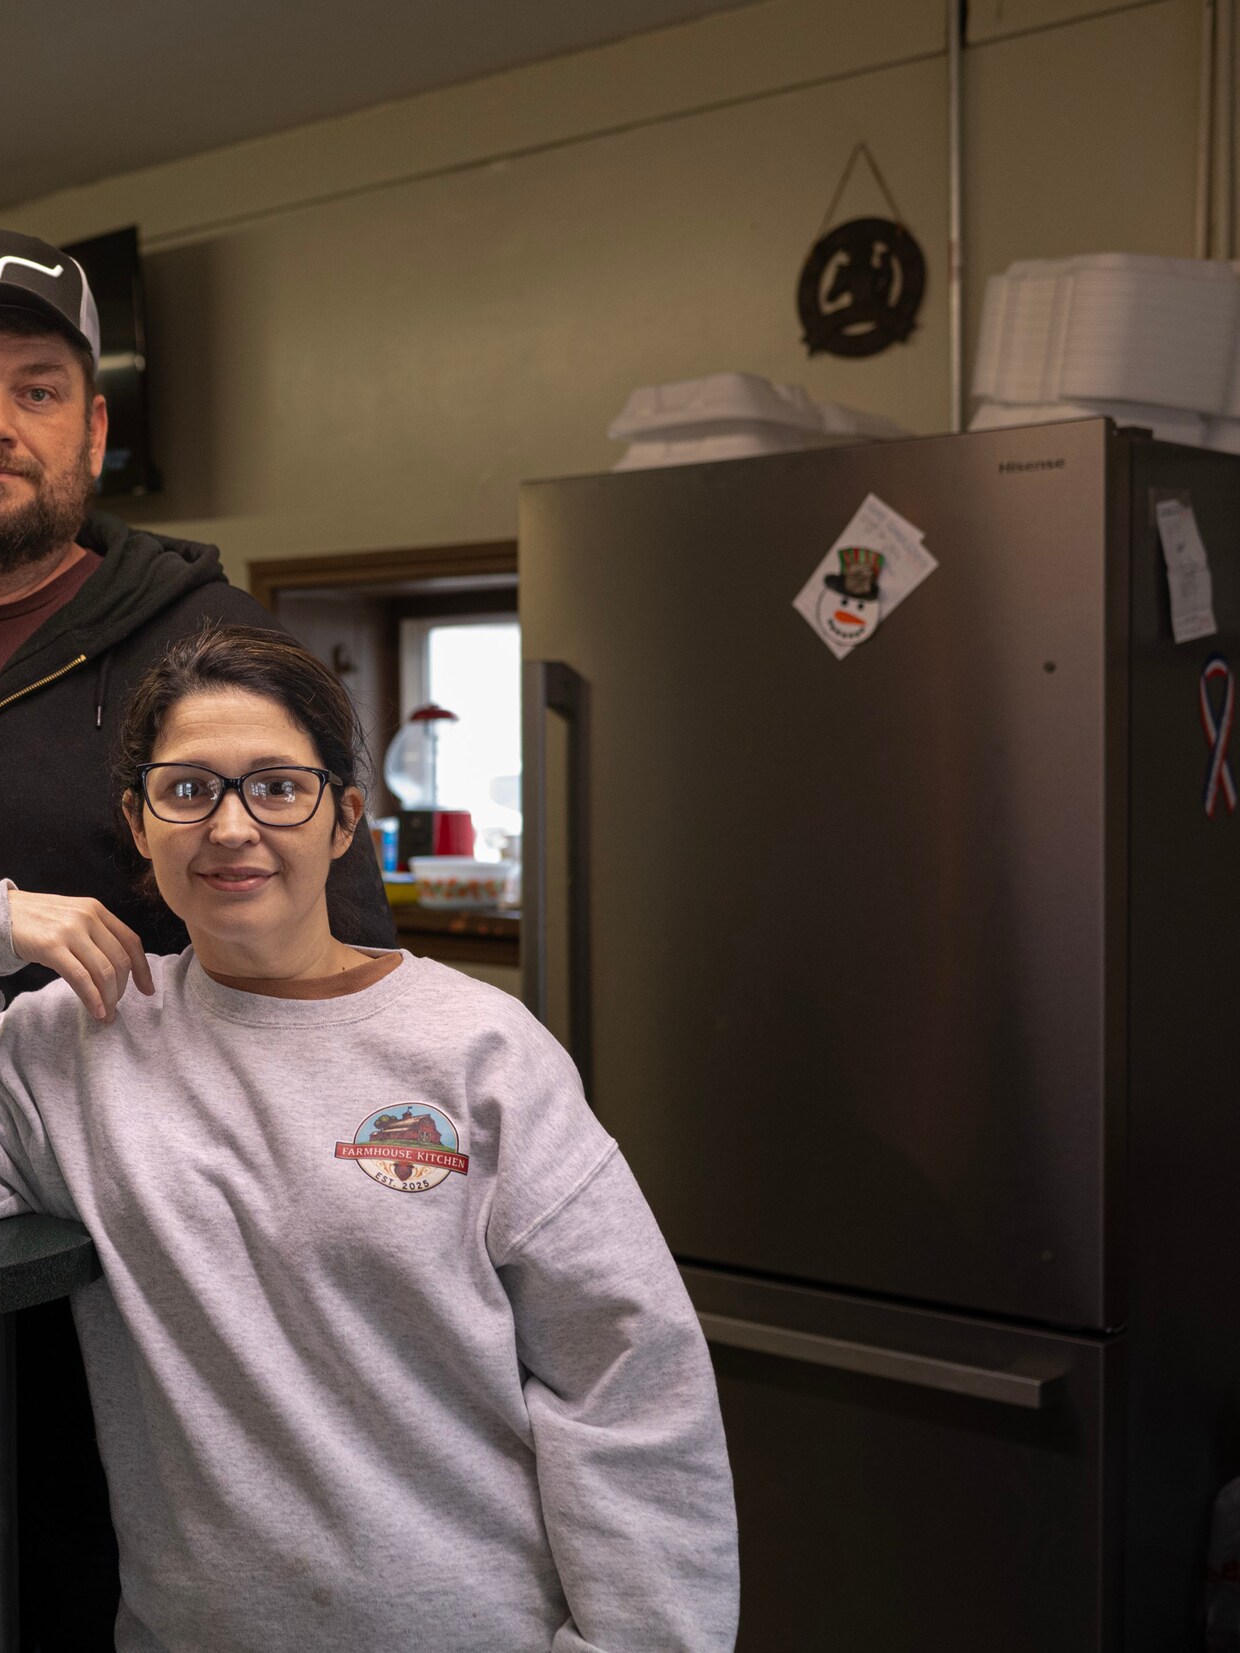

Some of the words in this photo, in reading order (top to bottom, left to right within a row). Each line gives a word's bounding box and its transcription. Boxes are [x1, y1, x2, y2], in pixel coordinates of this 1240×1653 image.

[341, 1146, 413, 1159] FARMHOUSE
[416, 1151, 466, 1169] KITCHEN
[374, 1172, 396, 1188] EST.
[402, 1180, 430, 1191] 2025
